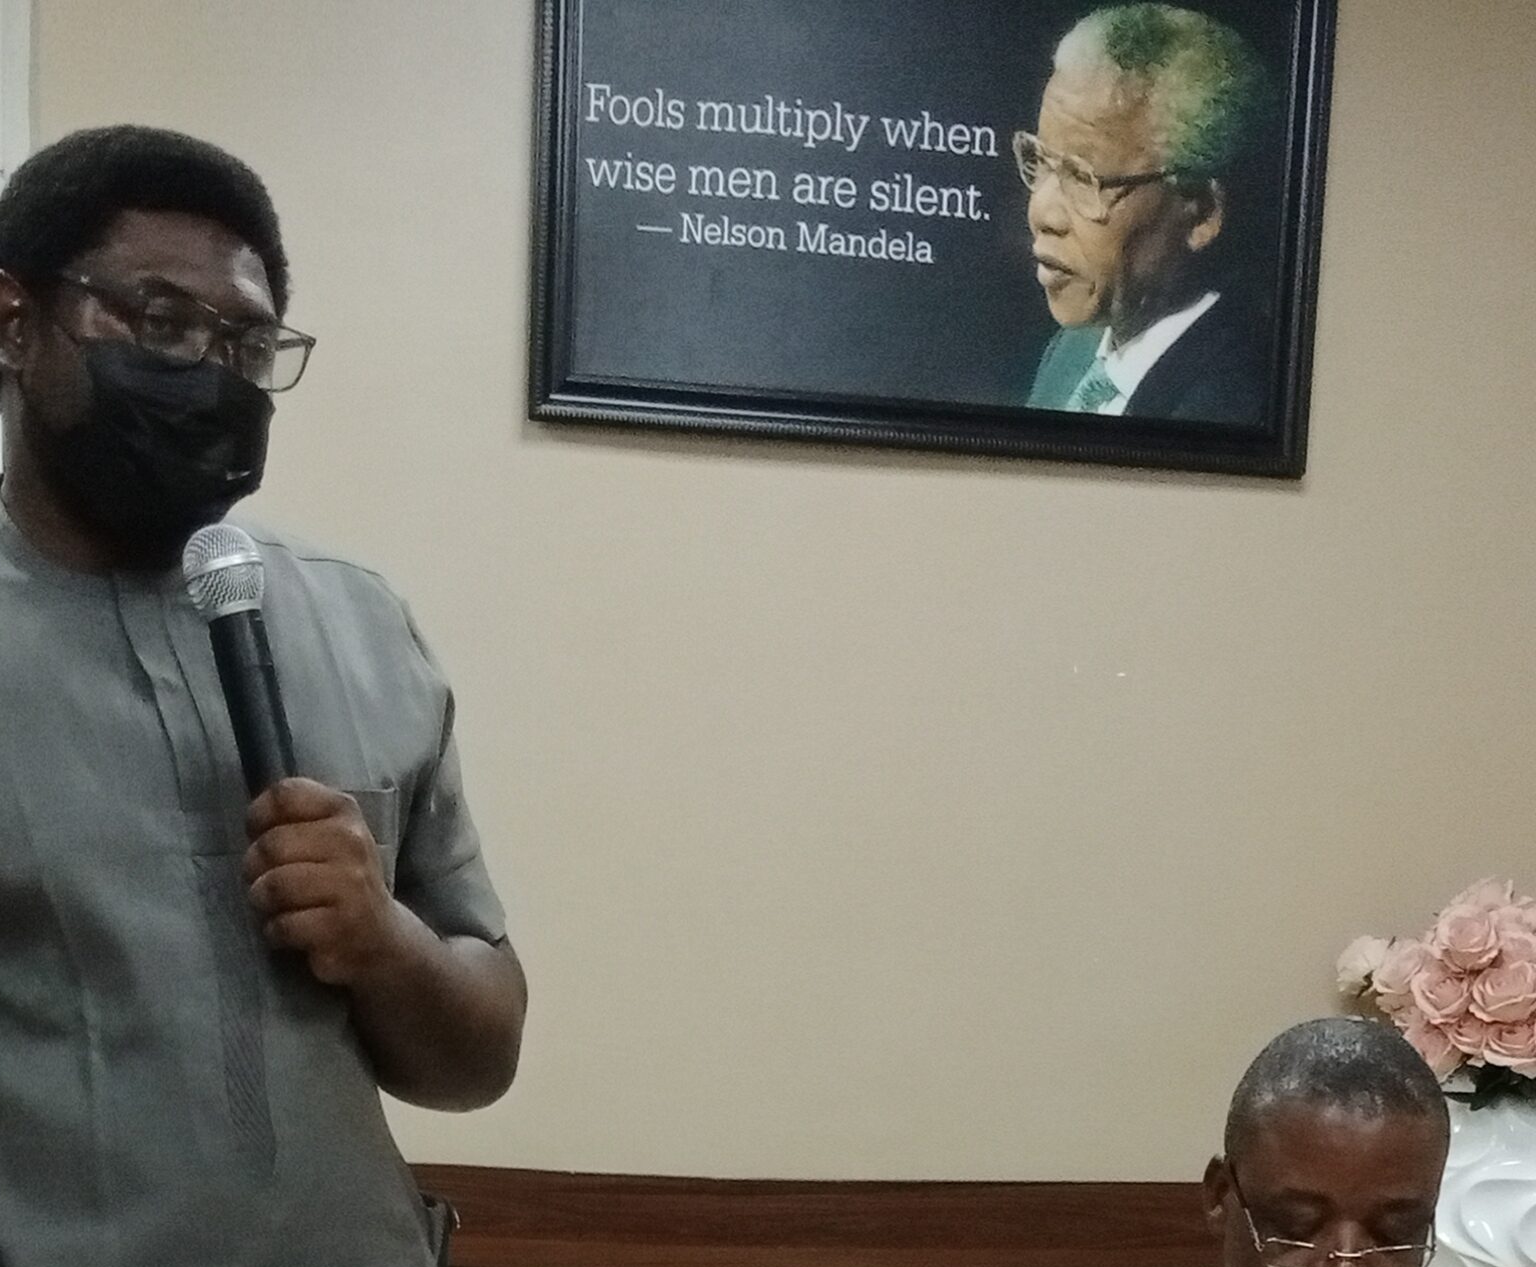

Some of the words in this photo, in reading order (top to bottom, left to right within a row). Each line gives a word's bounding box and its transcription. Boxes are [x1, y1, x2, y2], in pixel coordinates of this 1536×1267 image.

[584, 83, 685, 132] Fools
[695, 94, 870, 149] multiply
[883, 113, 999, 158] when
[585, 152, 676, 194] wise
[687, 167, 778, 202] men
[792, 173, 858, 209] are
[869, 174, 992, 221] silent.
[679, 213, 787, 252] Nelson
[796, 222, 934, 265] Mandela
